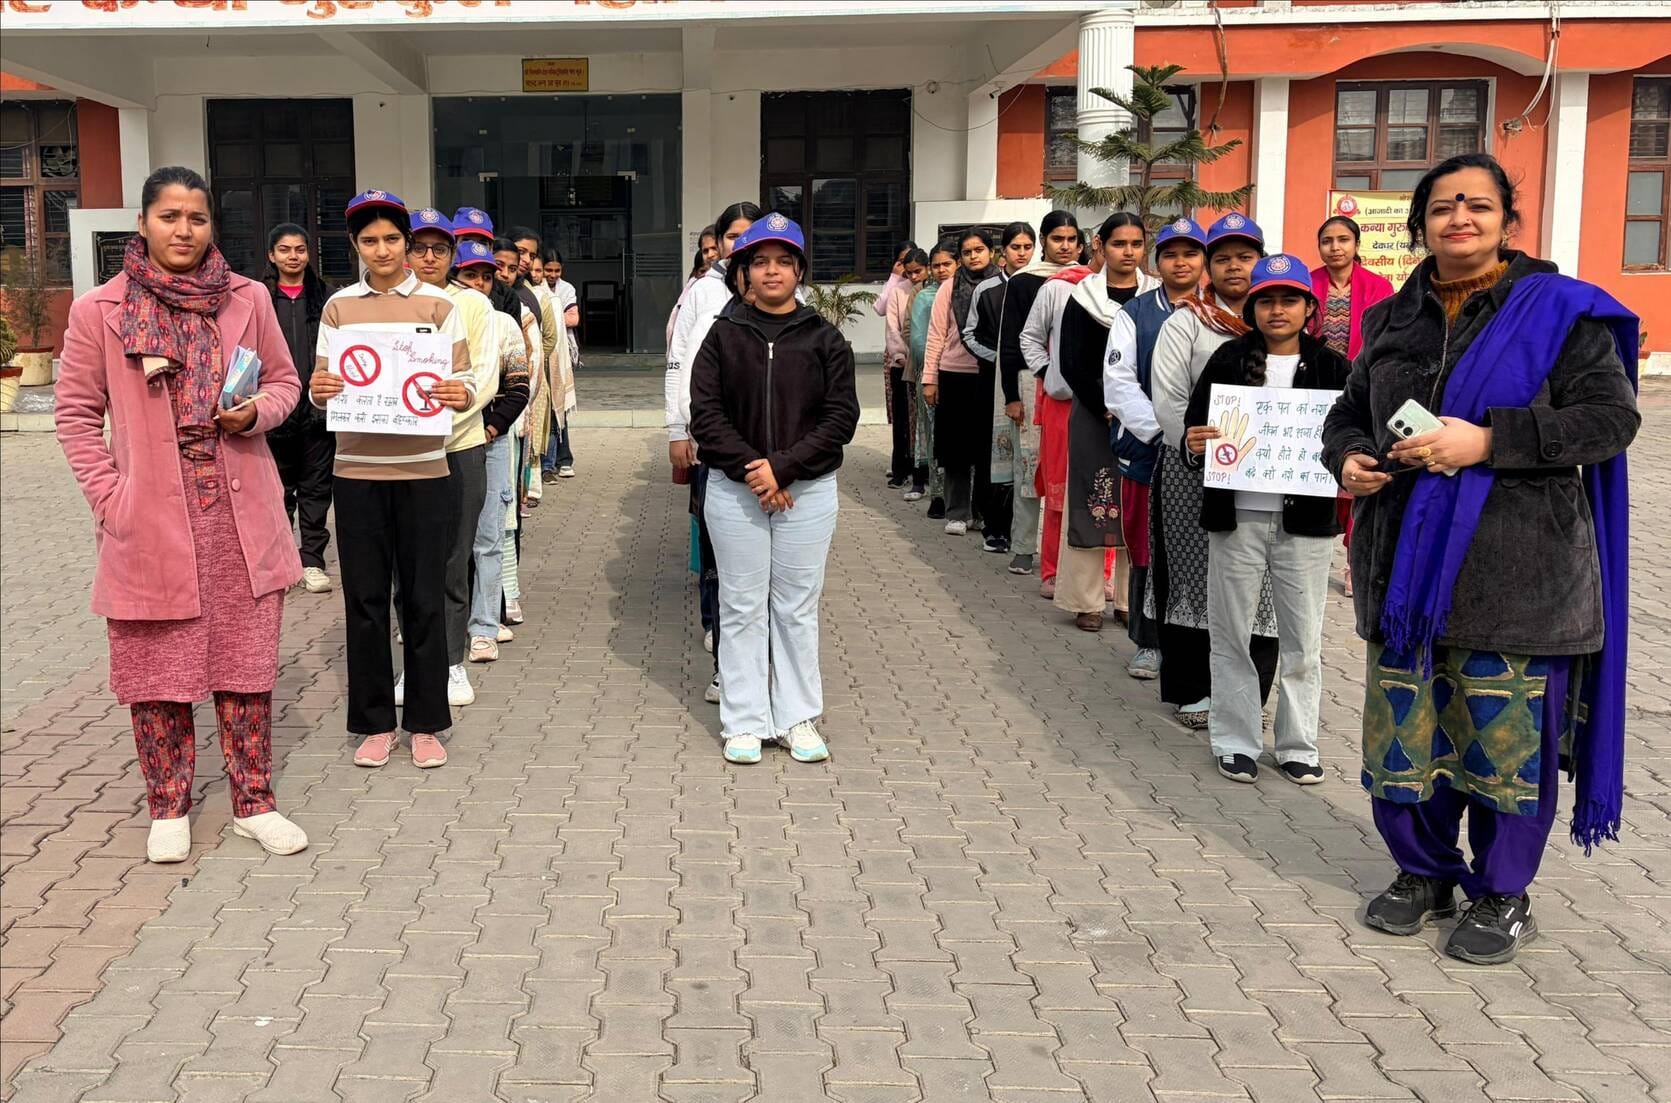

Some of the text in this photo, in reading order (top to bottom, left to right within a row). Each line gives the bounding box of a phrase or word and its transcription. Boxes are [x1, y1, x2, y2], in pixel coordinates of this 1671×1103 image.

[1360, 223, 1385, 233] कन्या
[1213, 394, 1241, 407] STOP!
[1206, 471, 1231, 485] STOP!
